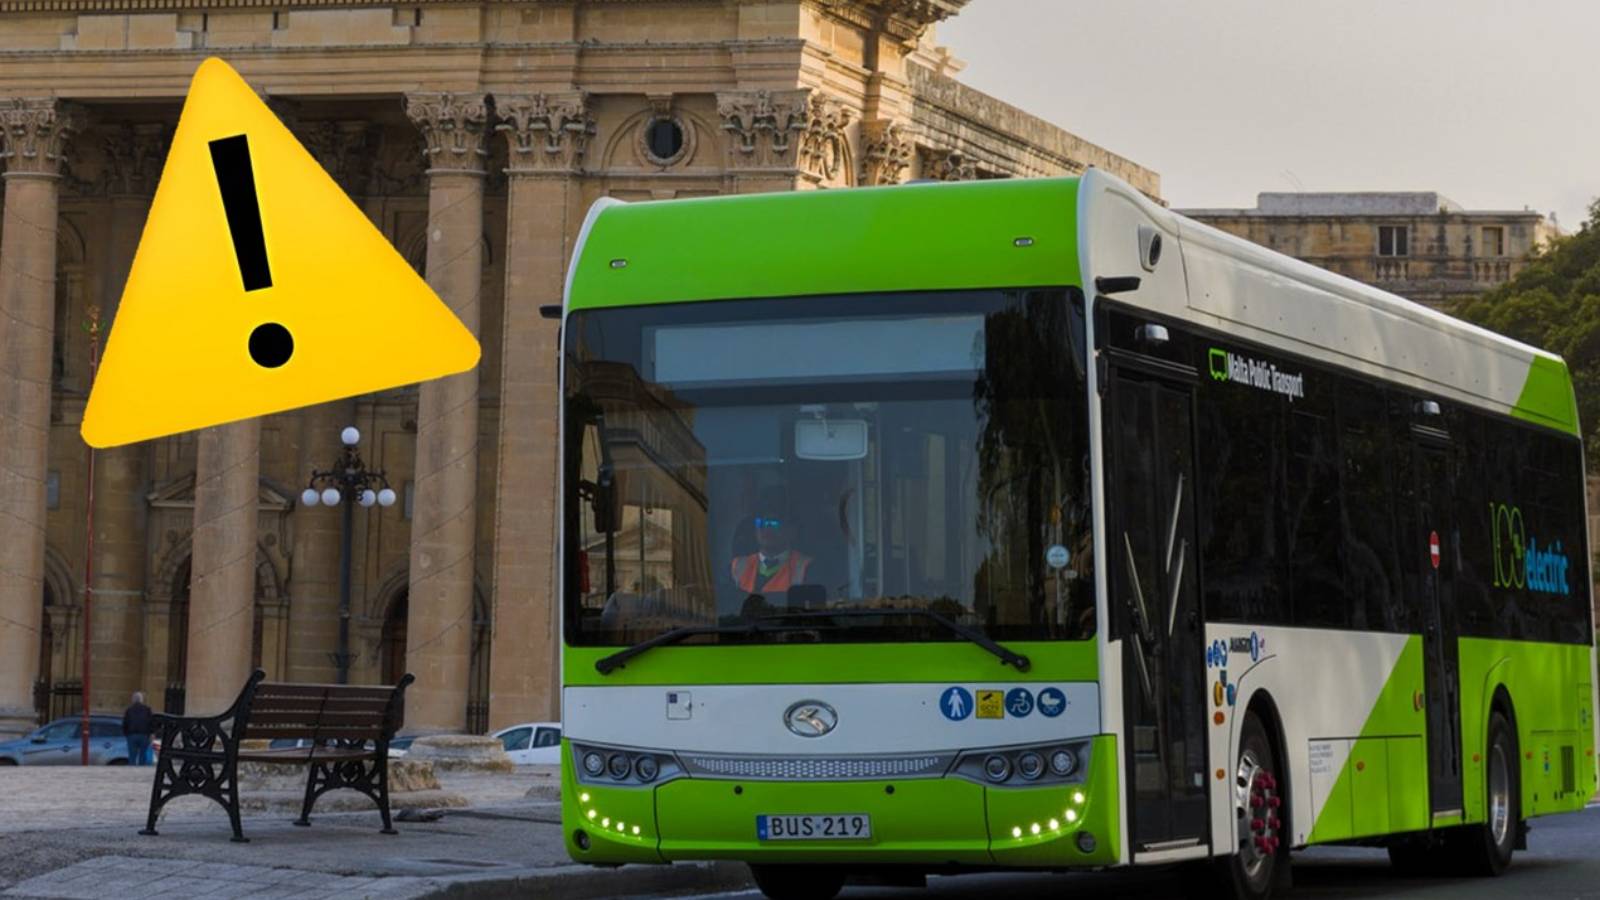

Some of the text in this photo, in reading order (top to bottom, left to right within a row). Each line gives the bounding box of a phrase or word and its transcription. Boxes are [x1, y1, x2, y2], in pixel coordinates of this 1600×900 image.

[1227, 351, 1304, 402] Malta Public Transport
[1525, 537, 1569, 595] electric
[771, 817, 864, 836] BUS 219
